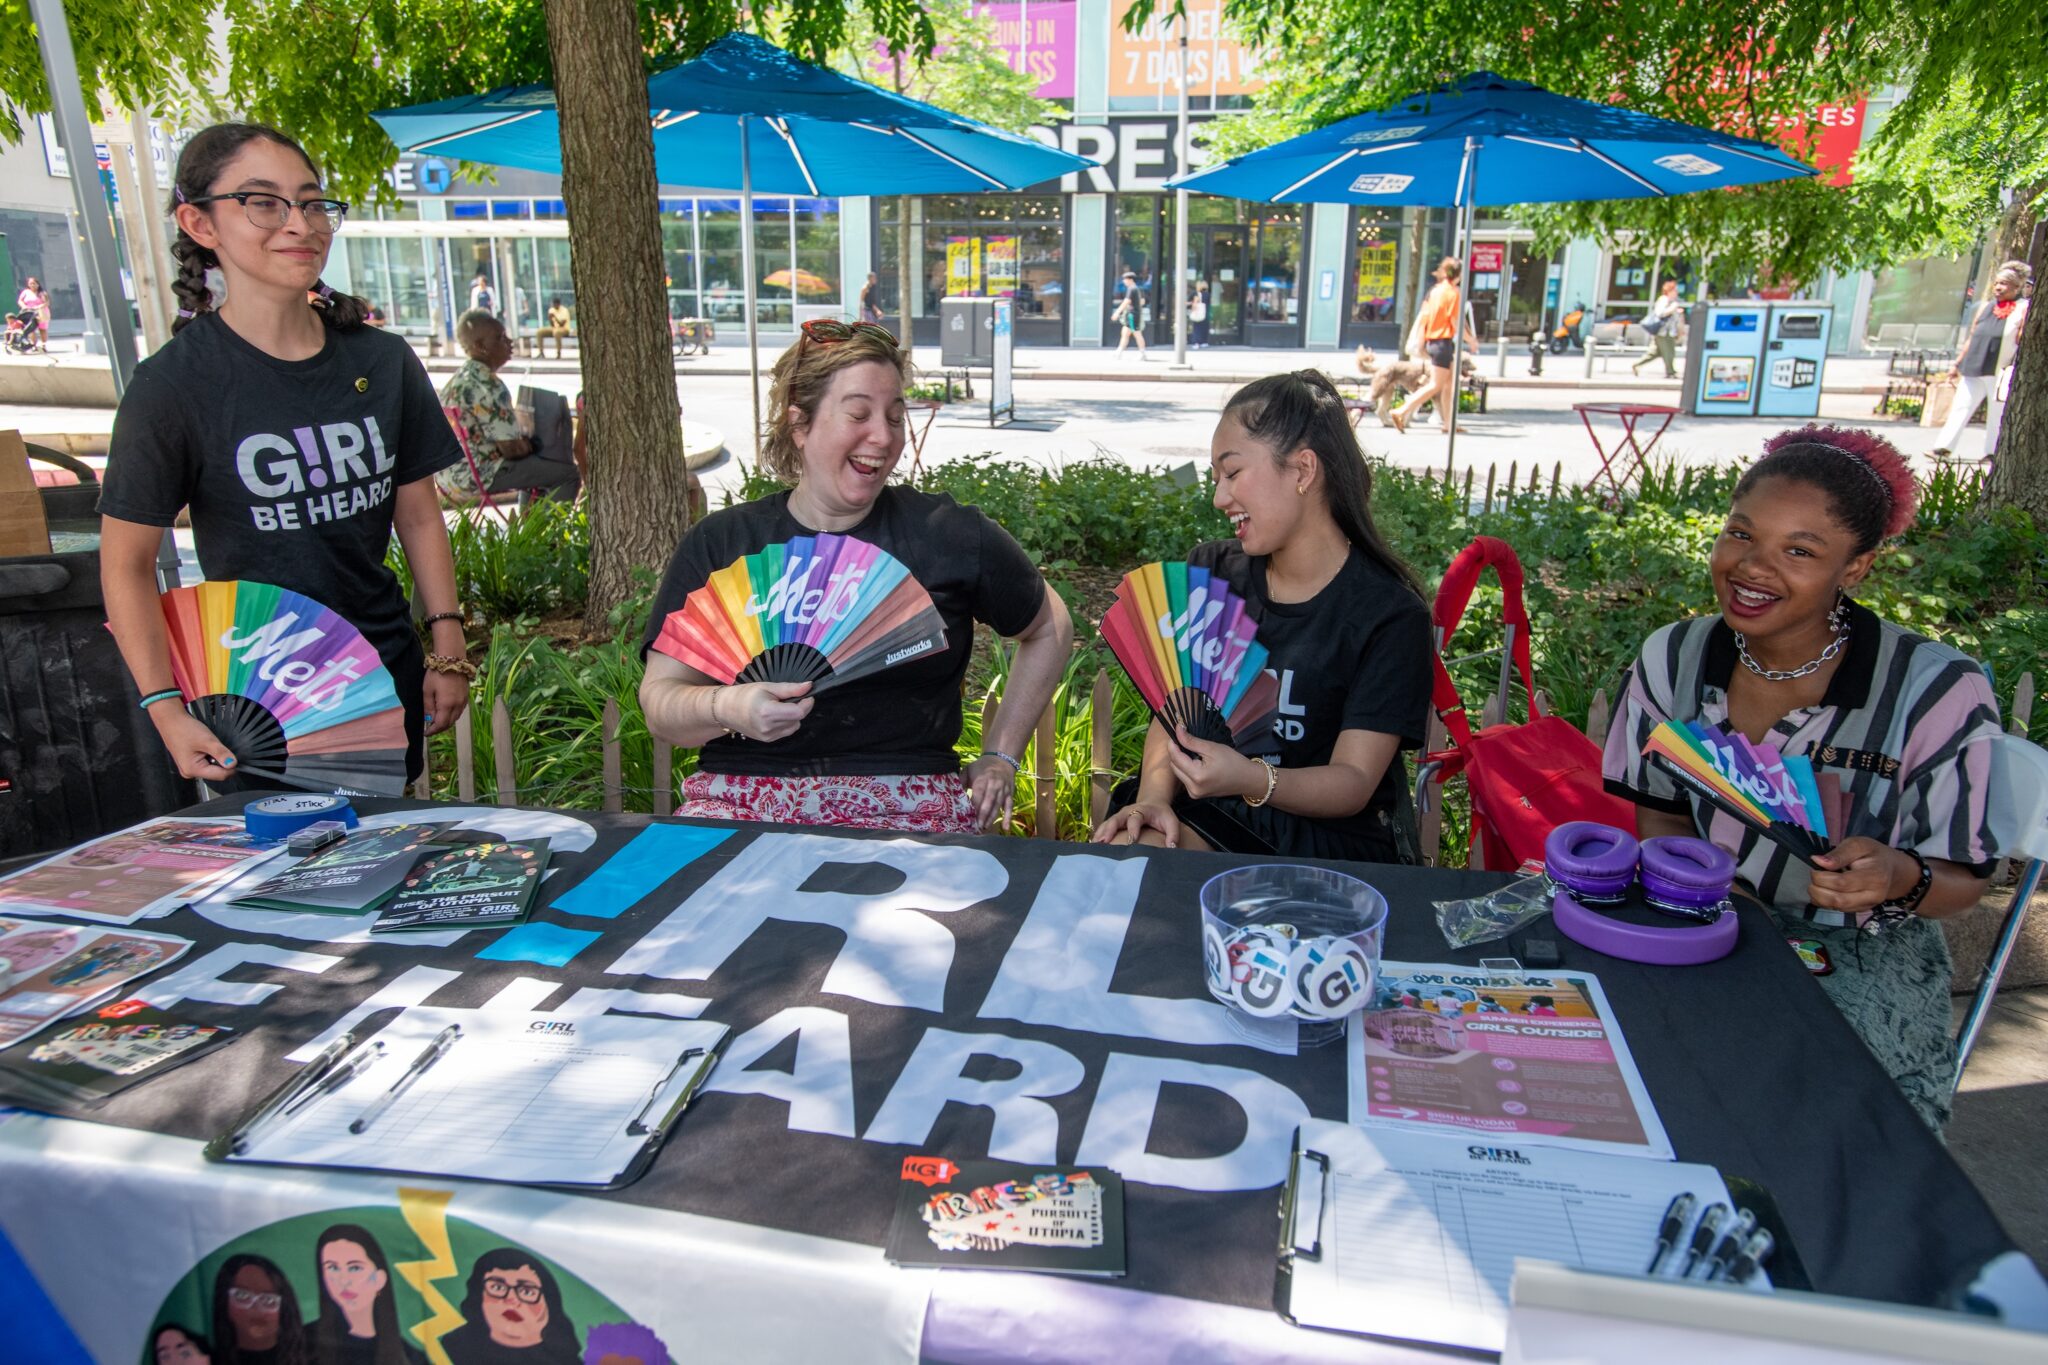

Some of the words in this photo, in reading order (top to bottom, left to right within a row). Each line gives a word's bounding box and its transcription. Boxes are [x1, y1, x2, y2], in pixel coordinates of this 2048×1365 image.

[1125, 52, 1142, 84] 7
[250, 502, 301, 531] BE
[306, 476, 393, 526] HEARD
[744, 555, 867, 625] Mets
[885, 638, 933, 666] Justworks
[220, 611, 362, 713] Mets
[440, 897, 492, 907] UTOPIA
[461, 890, 522, 900] PURSUIT
[1319, 959, 1361, 1009] G!
[1479, 1014, 1529, 1025] SUMMER
[1522, 1025, 1604, 1039] OUTSIDE!
[1051, 1198, 1074, 1208] THE
[1031, 1208, 1091, 1220] PURSUIT
[1029, 1226, 1086, 1240] UTOPIA
